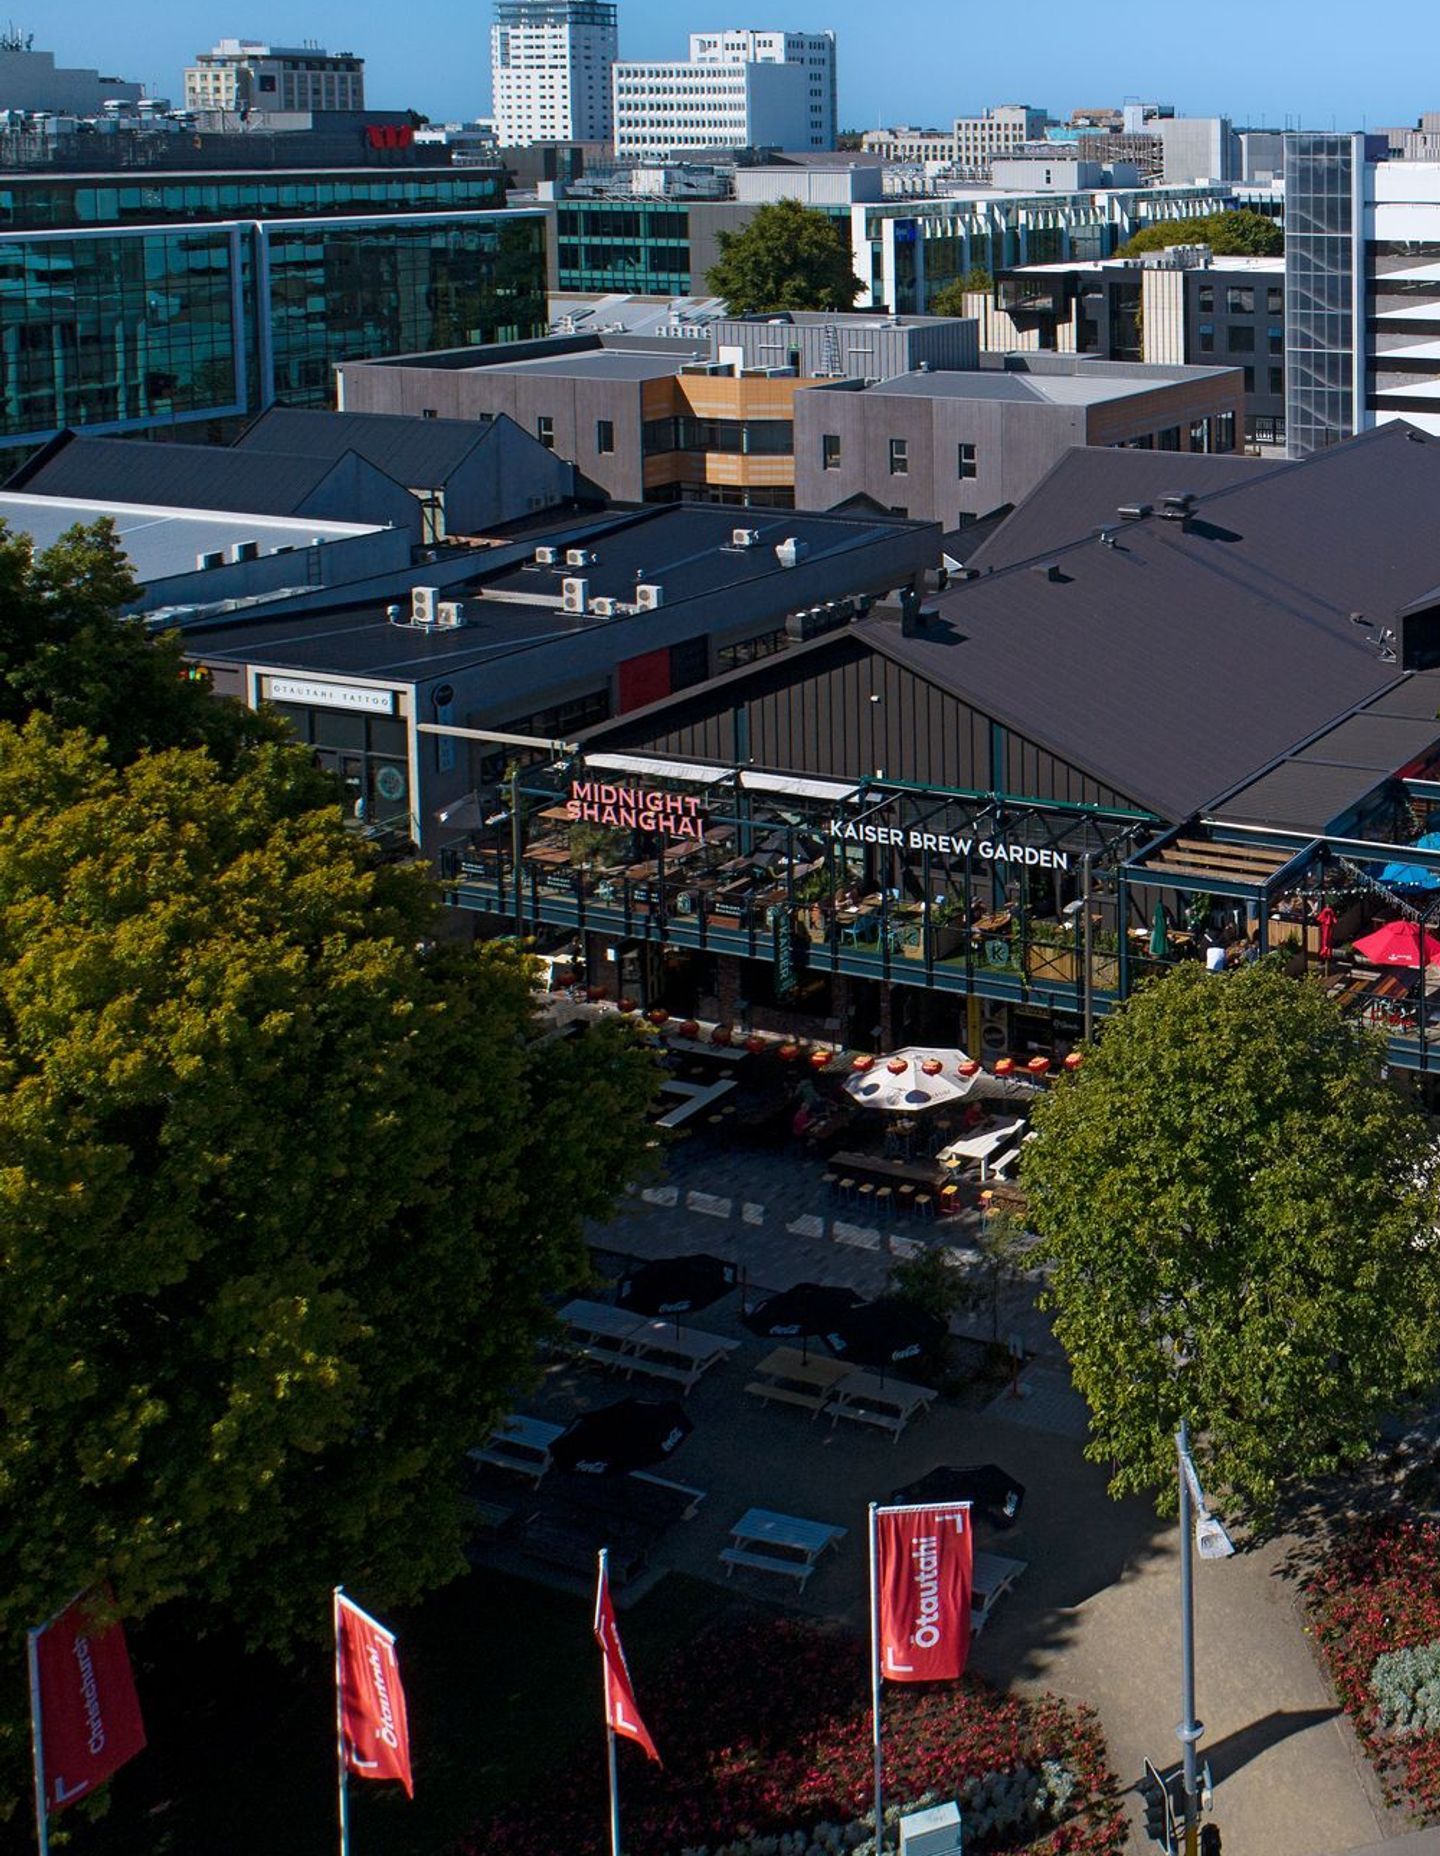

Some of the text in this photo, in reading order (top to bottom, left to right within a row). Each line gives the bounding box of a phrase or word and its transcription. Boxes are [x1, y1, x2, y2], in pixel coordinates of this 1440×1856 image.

[343, 693, 389, 706] TATTOO
[566, 799, 704, 840] SHANGHAI
[572, 780, 700, 817] MIDNIGHT
[830, 819, 1068, 870] KAISER BREW GARDEN
[910, 1535, 940, 1649] Ōtautahi
[71, 1636, 105, 1756] Christchurch
[368, 1645, 399, 1749] Ōtautahi
